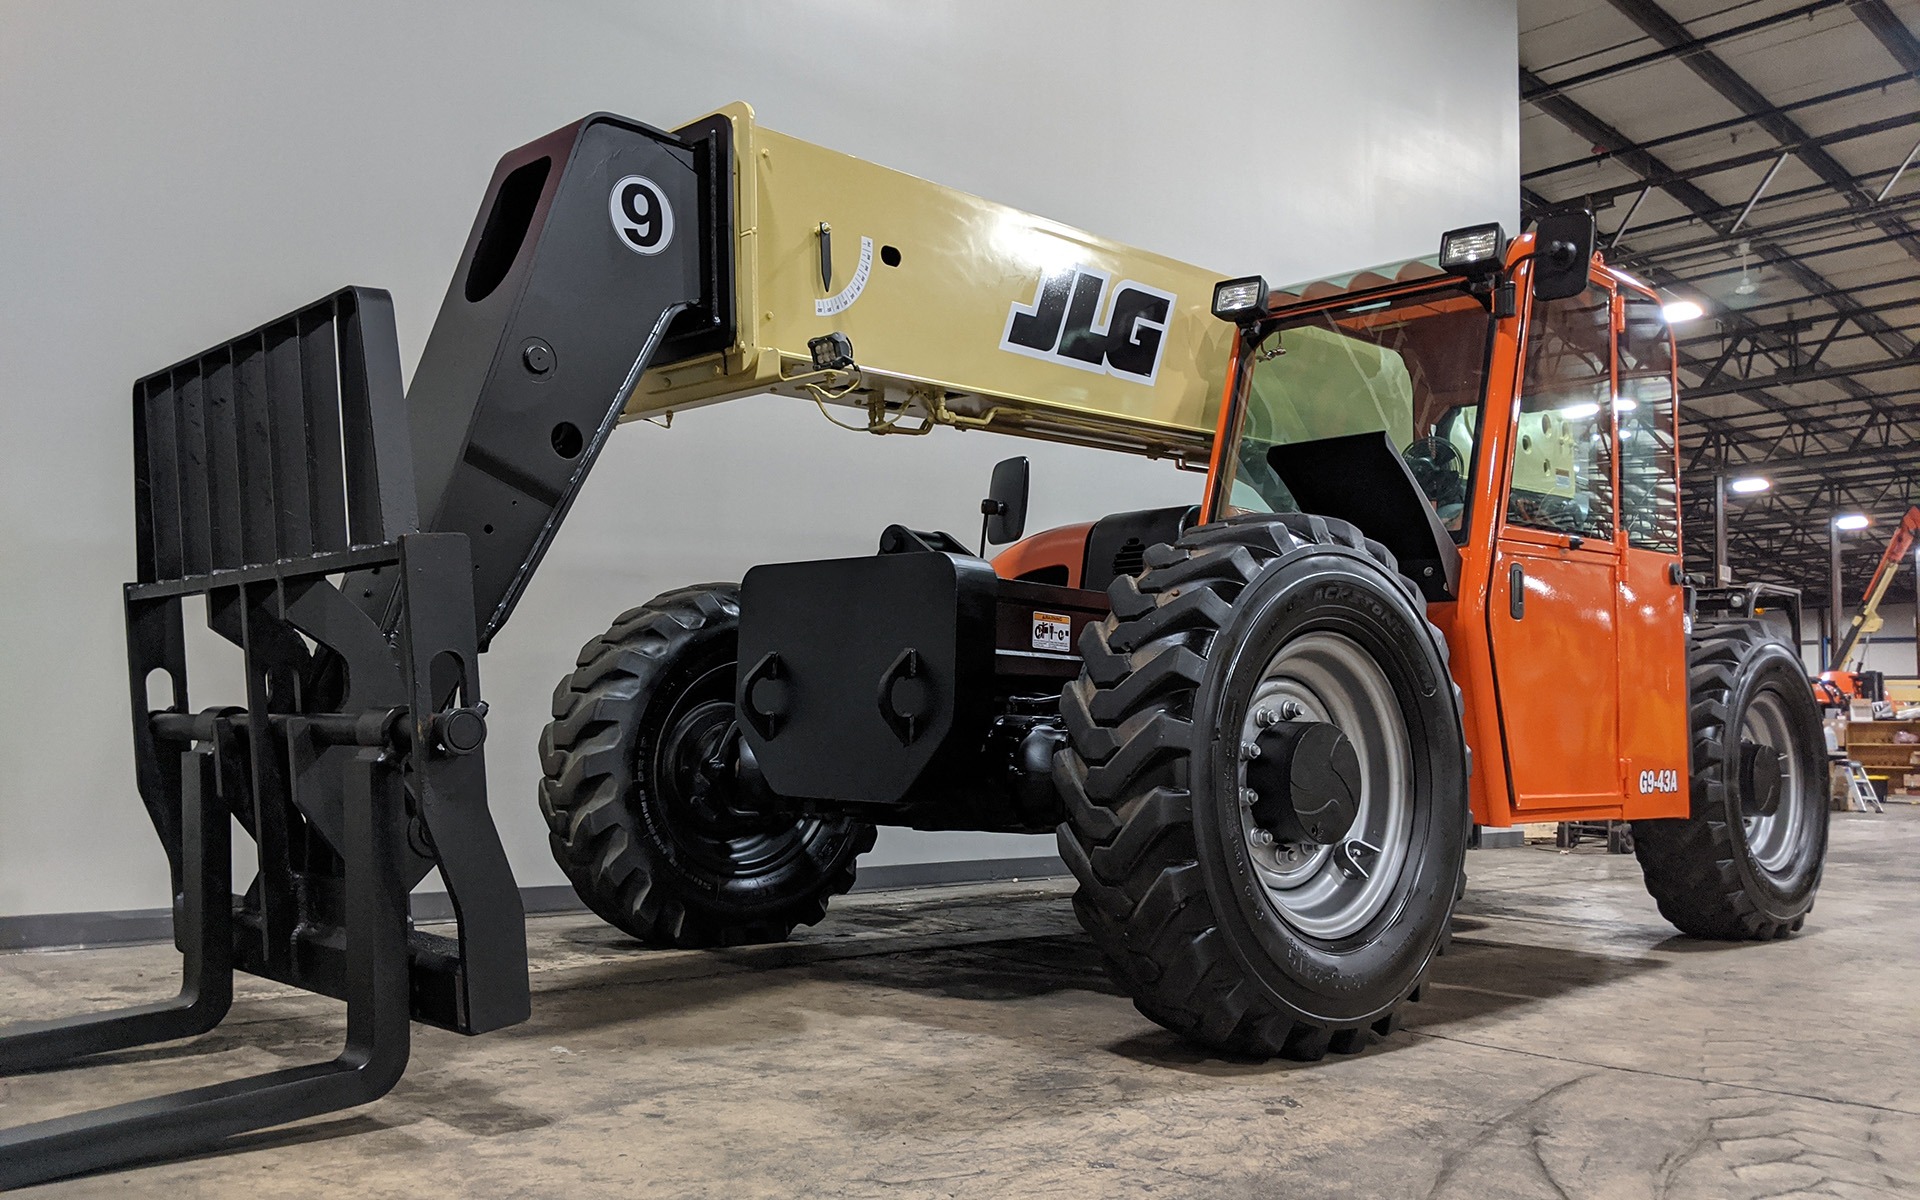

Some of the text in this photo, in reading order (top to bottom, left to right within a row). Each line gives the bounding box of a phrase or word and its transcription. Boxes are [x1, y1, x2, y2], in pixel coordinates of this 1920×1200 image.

[621, 183, 663, 247] 9
[1002, 265, 1174, 382] JLG
[1639, 769, 1678, 793] G9-43A
